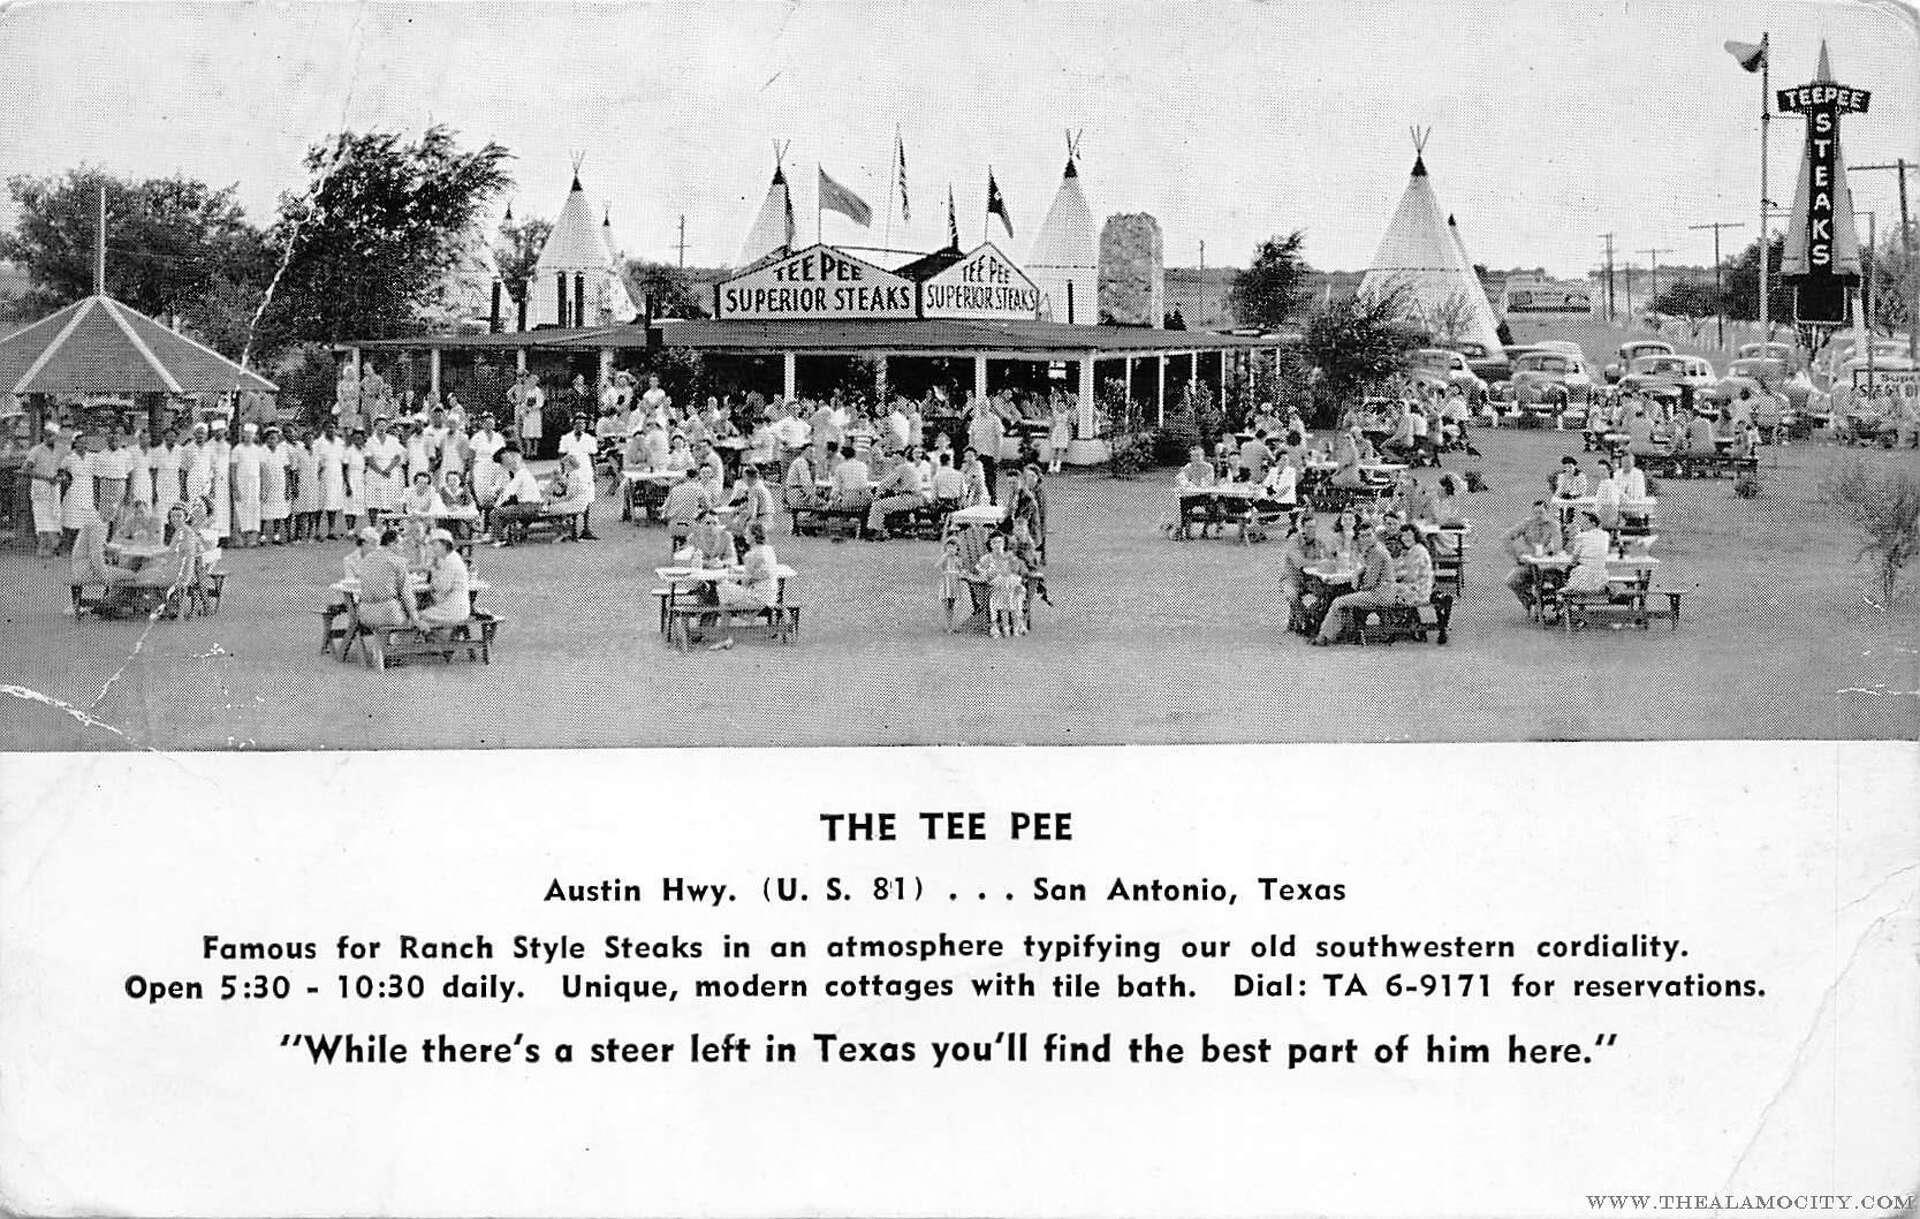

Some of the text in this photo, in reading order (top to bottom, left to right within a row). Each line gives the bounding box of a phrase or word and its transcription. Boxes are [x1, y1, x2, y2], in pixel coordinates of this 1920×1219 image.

[1784, 86, 1865, 109] TEEPEE
[1811, 112, 1832, 266] STEAKS
[773, 250, 863, 282] TEE PEE
[962, 255, 1010, 284] TEE PEE
[725, 285, 911, 314] SUPERIOR STEAKS
[926, 284, 1036, 312] SUPERIOR STEAKS
[820, 812, 1072, 841] THE TEE PEE
[544, 878, 640, 901] Austin
[663, 878, 735, 906] Hwy.
[764, 877, 807, 902] (U.
[827, 878, 850, 901] S.
[874, 877, 922, 901] 81)
[1034, 877, 1085, 901] San
[1107, 878, 1236, 905] Antonio,
[1258, 878, 1345, 900] Texas
[204, 933, 1688, 964] Famous for Ranch Style Steaks in an atmosphere typifying our old southwestern cordiality.
[125, 975, 202, 1004] Open
[221, 975, 290, 1000] 5:30
[339, 974, 424, 998] 10:30
[443, 974, 524, 1003] daily.
[563, 974, 677, 1002] Unique,
[696, 974, 806, 997] modern
[826, 975, 953, 1001] cottages
[971, 972, 1034, 996] with
[1053, 974, 1100, 997] tile
[1118, 974, 1195, 997] bath.
[1235, 974, 1305, 997] Dial:
[1323, 973, 1367, 996] TA
[1386, 974, 1488, 997] 6-9171
[1512, 974, 1555, 997] for
[1574, 974, 1765, 997] reservations.
[281, 1032, 1617, 1069] "While there's a steer left in Texas you'll find the best part of him here."
